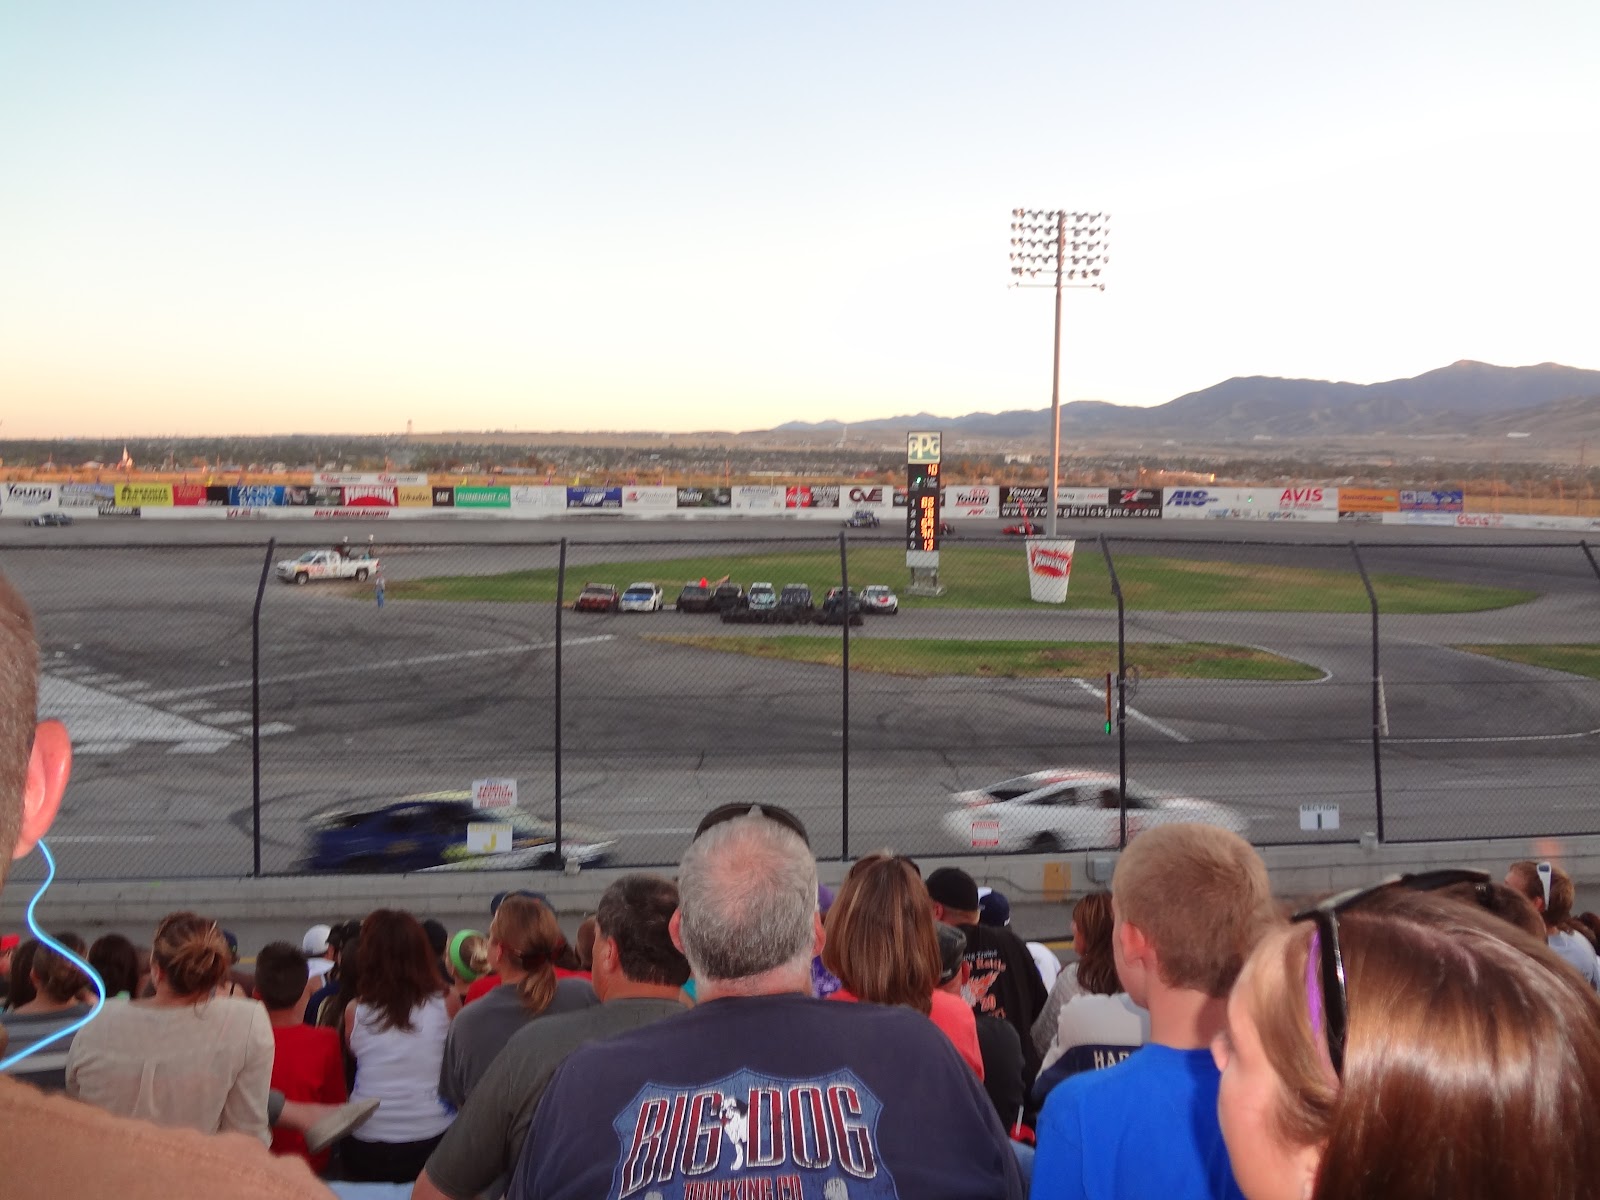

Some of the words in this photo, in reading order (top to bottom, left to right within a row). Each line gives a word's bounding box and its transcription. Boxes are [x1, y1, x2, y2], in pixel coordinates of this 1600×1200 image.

[908, 434, 940, 459] PPG
[7, 484, 52, 500] Young
[956, 492, 989, 505] Young
[1008, 487, 1043, 498] Young
[1280, 487, 1323, 502] AVIS
[1001, 507, 1160, 519] www.yongbuickgmc.com
[482, 833, 497, 853] J
[618, 1089, 724, 1200] BIG
[746, 1084, 878, 1179] DOG
[683, 1176, 773, 1200] TRUCKING
